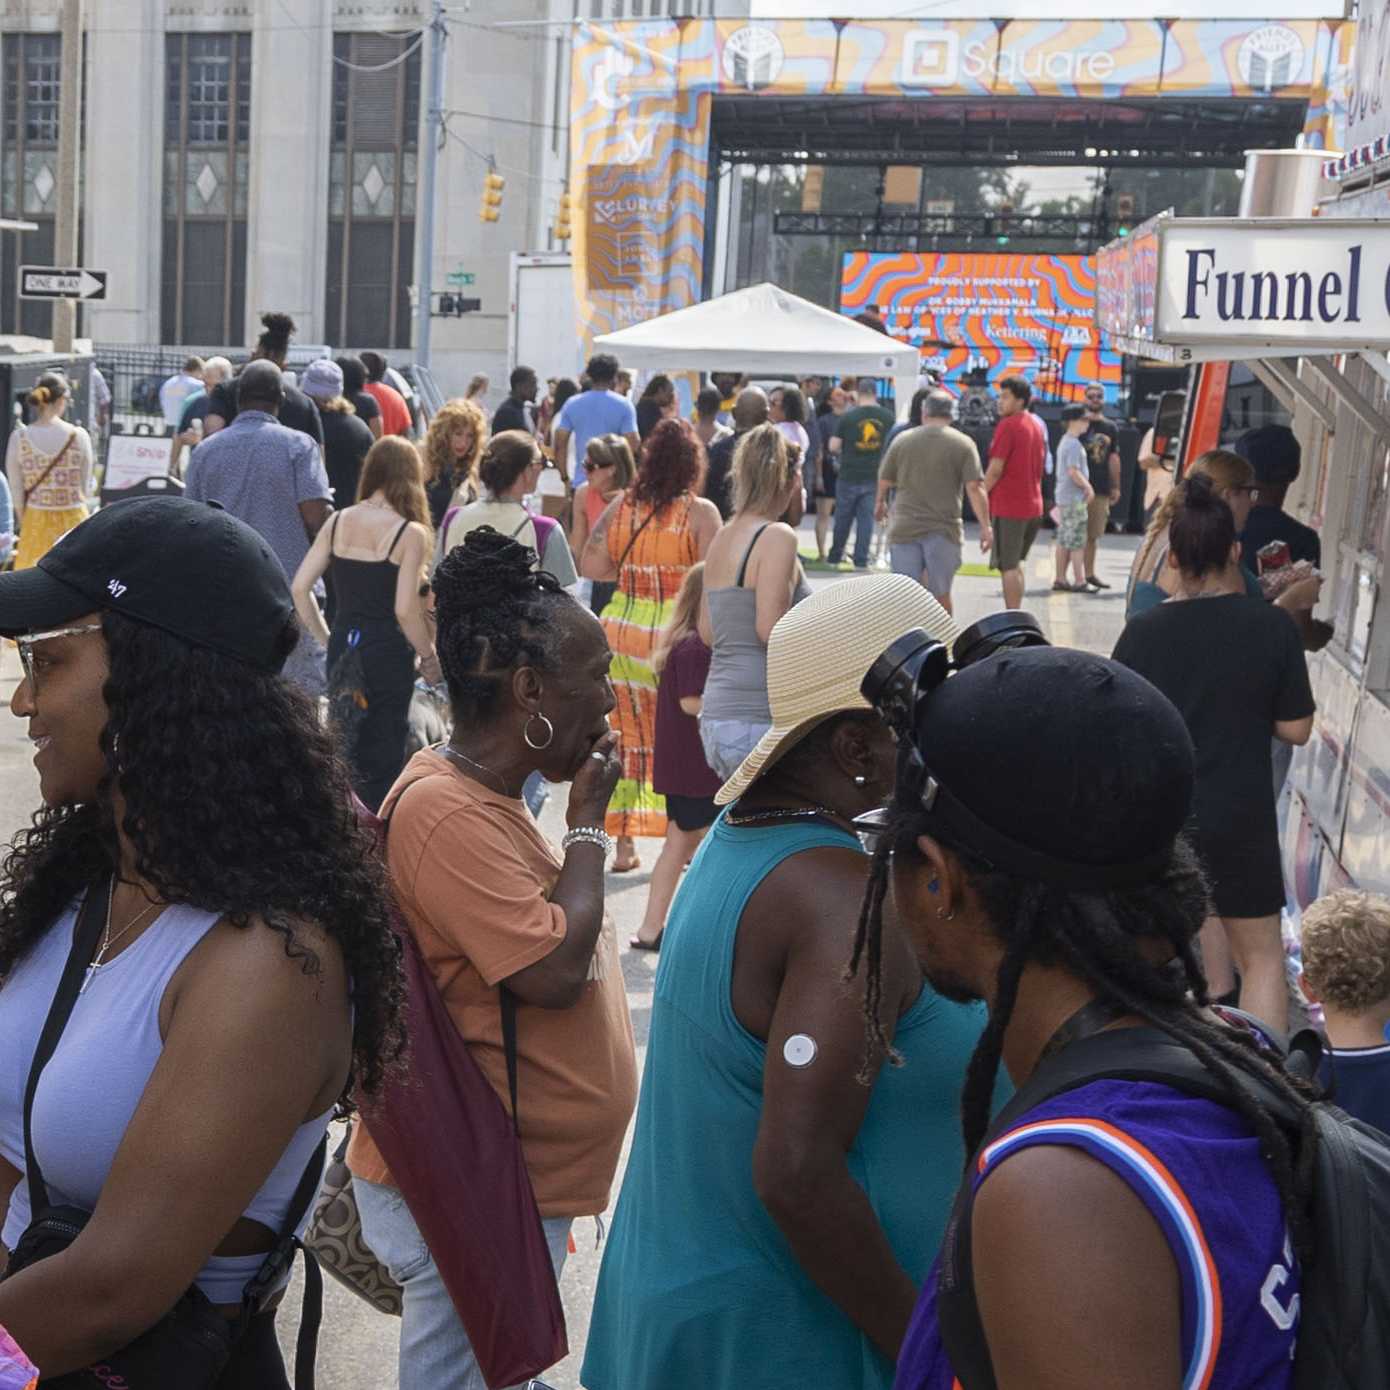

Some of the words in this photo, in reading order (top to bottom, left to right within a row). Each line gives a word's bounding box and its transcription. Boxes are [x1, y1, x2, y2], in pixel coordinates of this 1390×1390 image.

[963, 39, 1114, 80] Square
[29, 276, 51, 289] ONE
[57, 279, 80, 289] WAY
[1181, 244, 1363, 323] Funnel
[986, 324, 1047, 342] Kettering
[1181, 349, 1192, 361] 3
